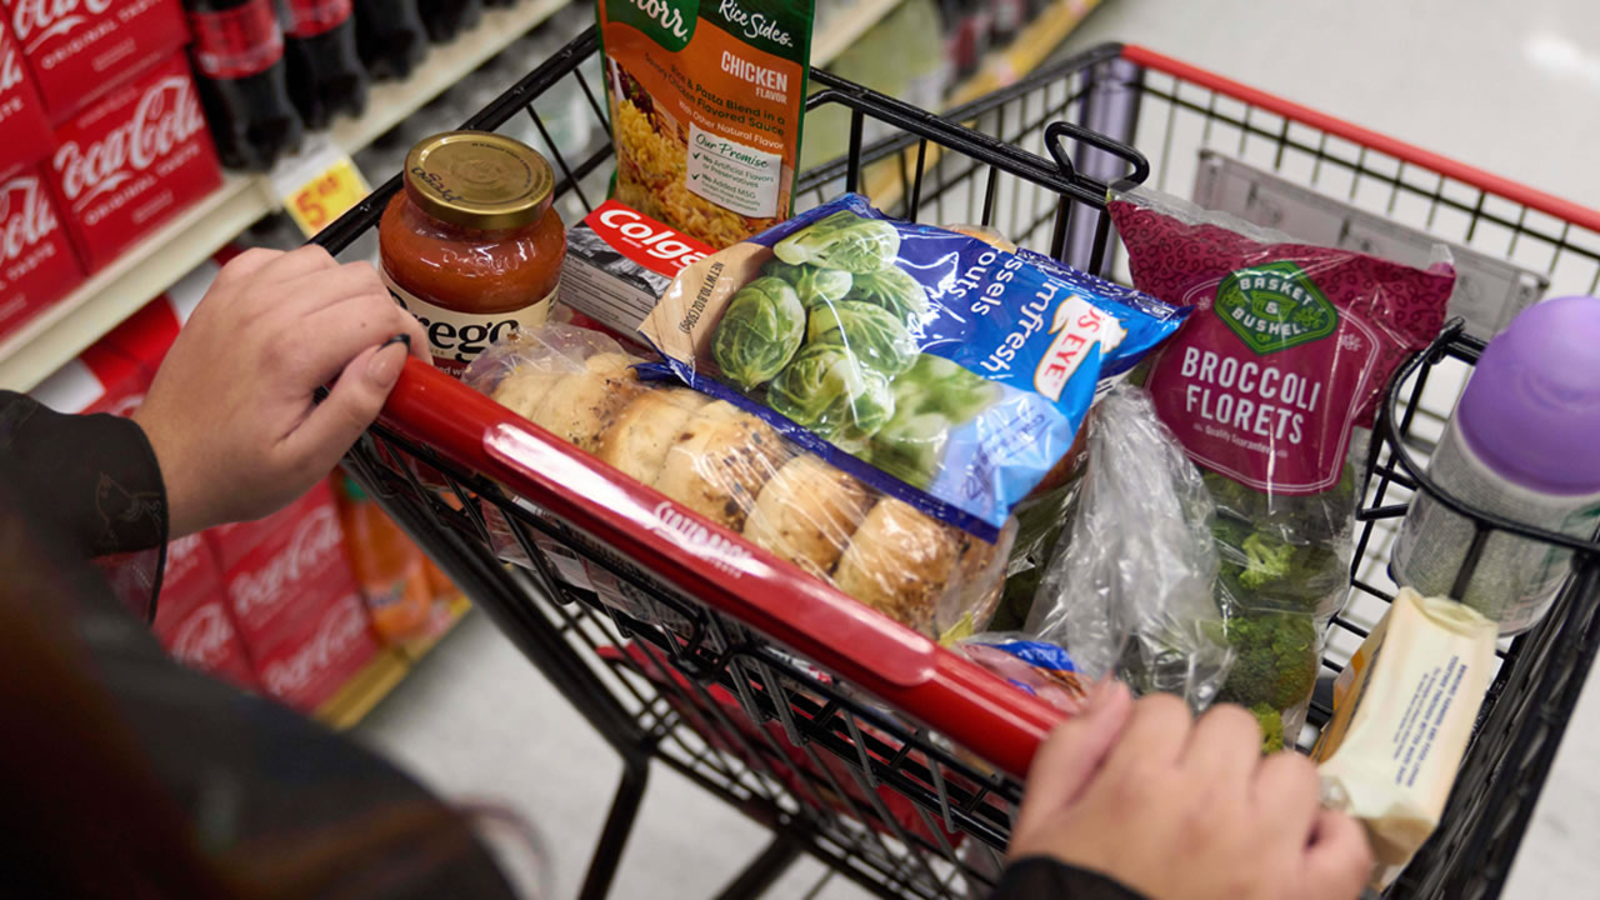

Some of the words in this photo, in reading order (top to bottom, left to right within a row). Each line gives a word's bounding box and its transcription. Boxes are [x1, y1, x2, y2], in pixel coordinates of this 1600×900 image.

[629, 0, 688, 38] orr
[719, 0, 749, 27] Rice
[744, 13, 790, 46] Sides
[721, 50, 788, 93] CHICKEN
[695, 83, 724, 106] Pasta
[726, 99, 761, 118] Blend
[763, 108, 775, 120] in
[778, 115, 786, 126] a
[755, 86, 788, 106] FLAVOR
[697, 97, 746, 124] Flavored
[749, 117, 784, 136] Sauce
[696, 133, 717, 149] Our
[719, 143, 768, 168] Promise
[717, 122, 753, 141] Natural
[753, 134, 784, 150] Flavor
[713, 177, 736, 192] Added
[737, 187, 756, 199] MSG
[714, 158, 744, 176] Artificial
[745, 170, 774, 183] Flavors
[600, 209, 709, 267] Colga
[703, 273, 718, 289] WT
[709, 261, 725, 277] NET
[947, 245, 1003, 298] outs
[970, 252, 1024, 316] ssels
[1239, 277, 1314, 306] BASKET
[1265, 301, 1279, 315] &
[386, 286, 520, 363] ego
[979, 278, 1060, 373] mfresh
[1231, 306, 1302, 336] BUSHEL
[1044, 332, 1087, 382] EYE
[1181, 346, 1321, 412] BROCCOLI
[1186, 384, 1304, 444] FLORETS
[1205, 424, 1231, 442] Quality
[1231, 433, 1275, 455] Guarantee
